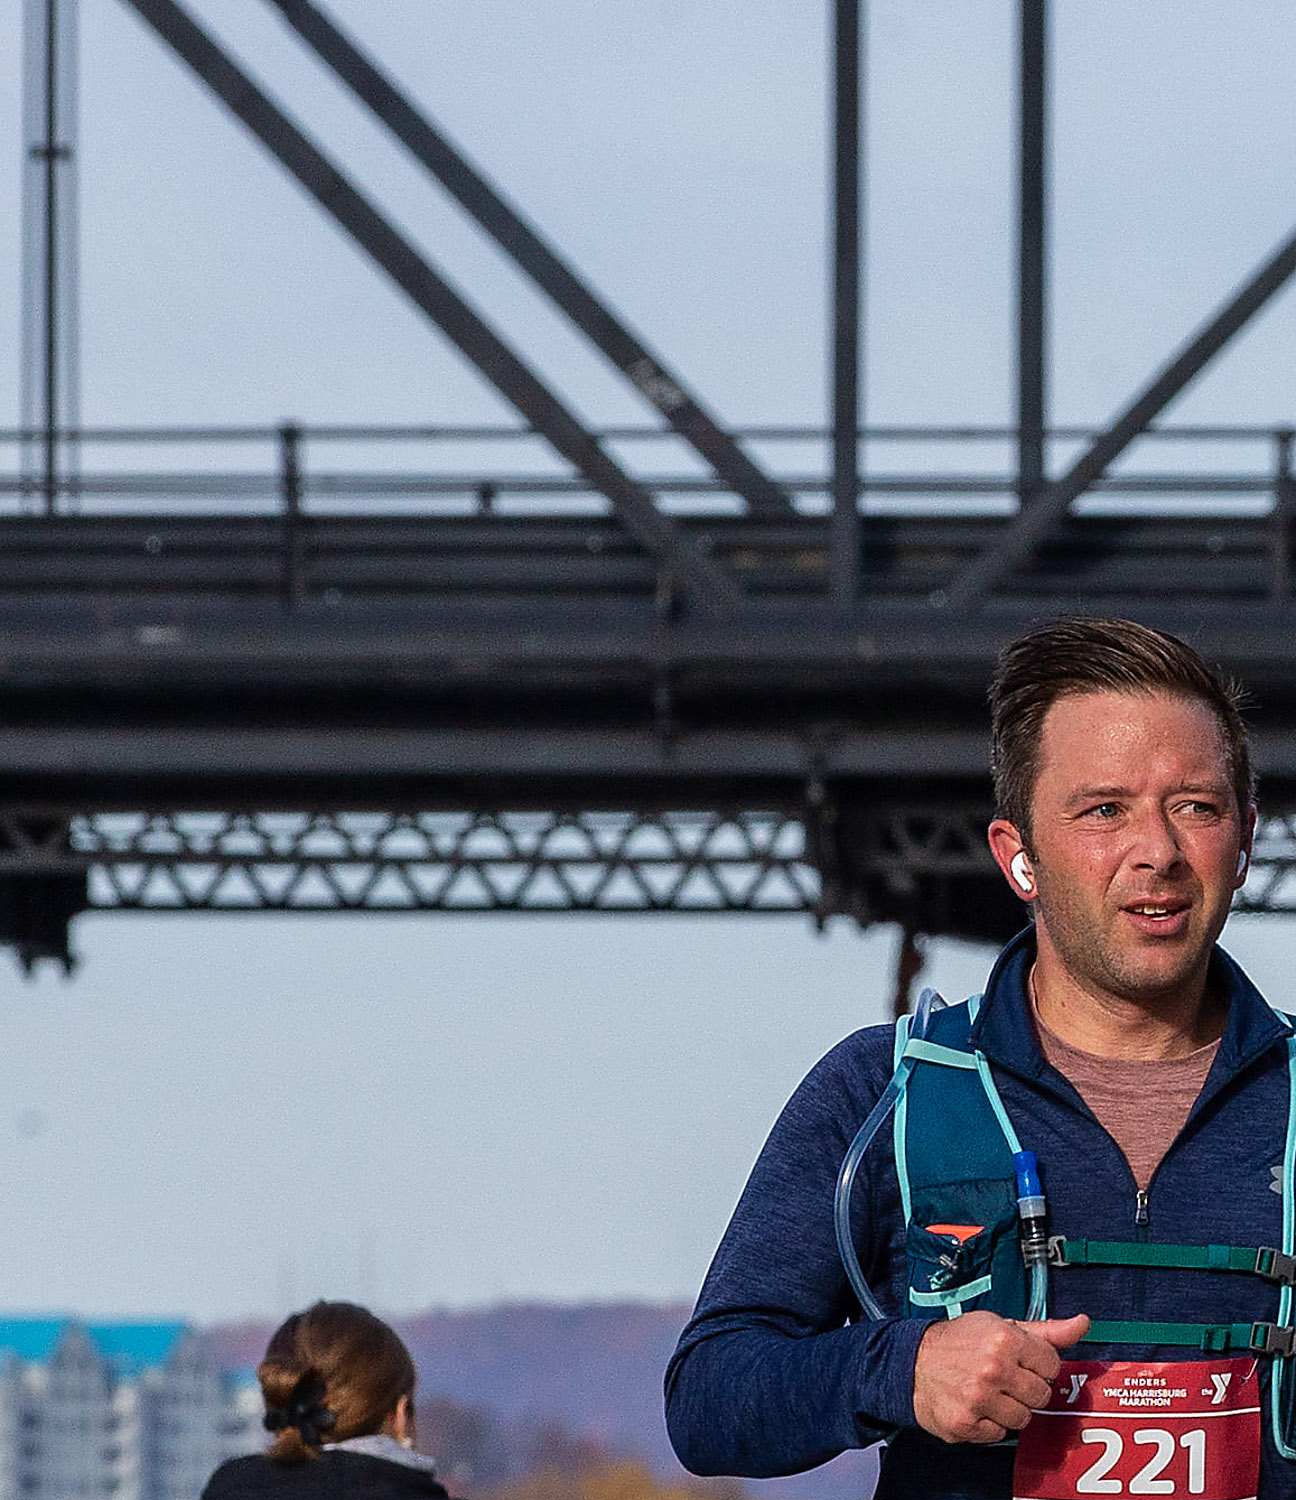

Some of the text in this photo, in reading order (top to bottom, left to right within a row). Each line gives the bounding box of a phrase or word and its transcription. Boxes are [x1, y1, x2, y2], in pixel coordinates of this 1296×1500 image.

[1123, 1378, 1168, 1387] ENDERS
[1103, 1387, 1187, 1398] YMCA HARRISBURG
[1118, 1397, 1171, 1407] MARATHON
[1076, 1428, 1206, 1495] 221
